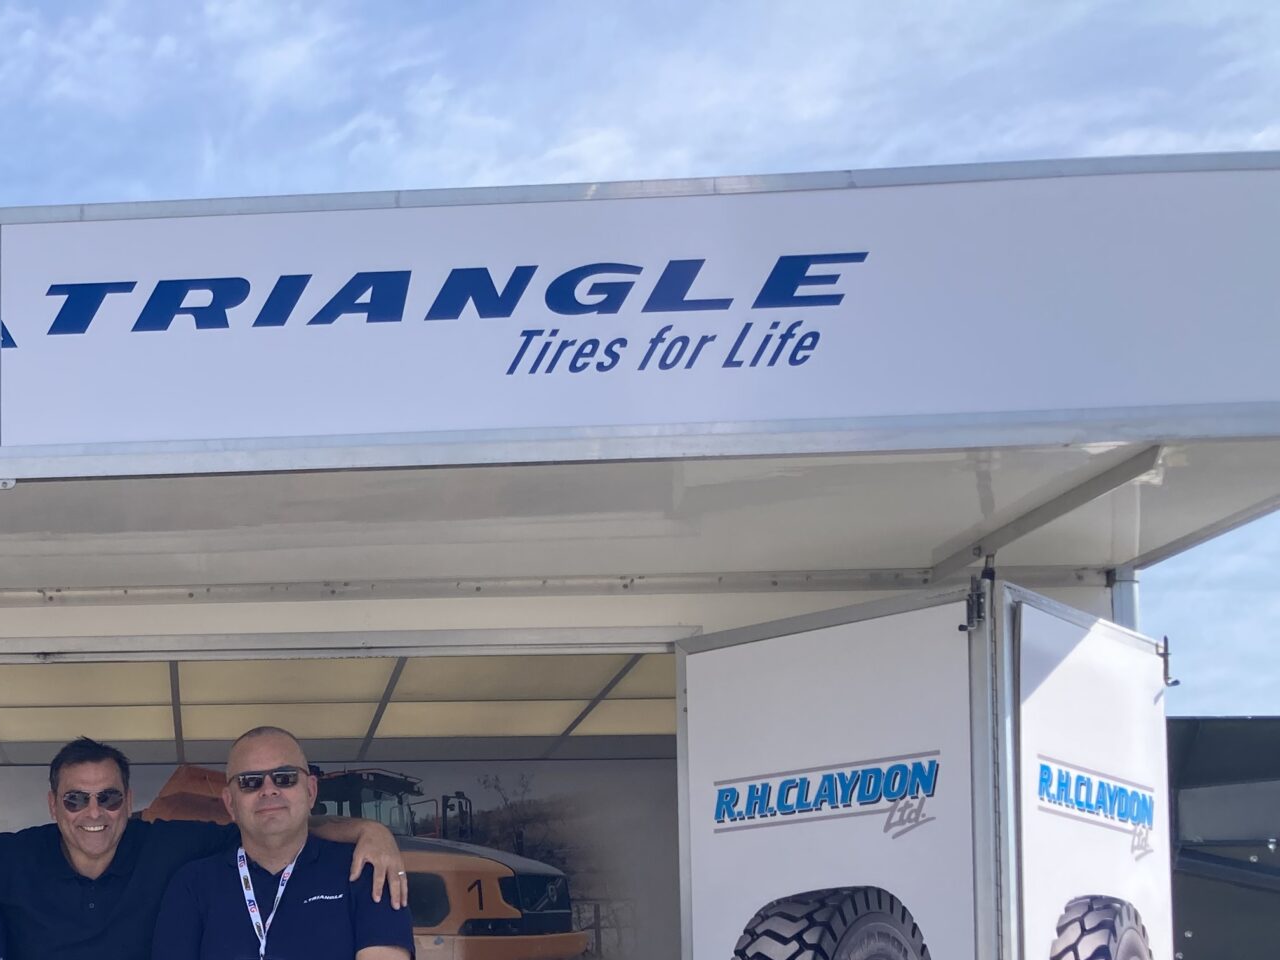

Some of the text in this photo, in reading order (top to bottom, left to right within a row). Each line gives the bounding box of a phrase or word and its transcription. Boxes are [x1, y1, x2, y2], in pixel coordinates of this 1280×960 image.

[44, 251, 870, 336] TRIANGLE
[505, 319, 821, 376] Tires for Life
[714, 759, 939, 824] R.H.CLAYDON
[883, 797, 927, 834] Ltd.
[1038, 763, 1154, 831] R.H.CLAYDON
[467, 879, 485, 911] 1
